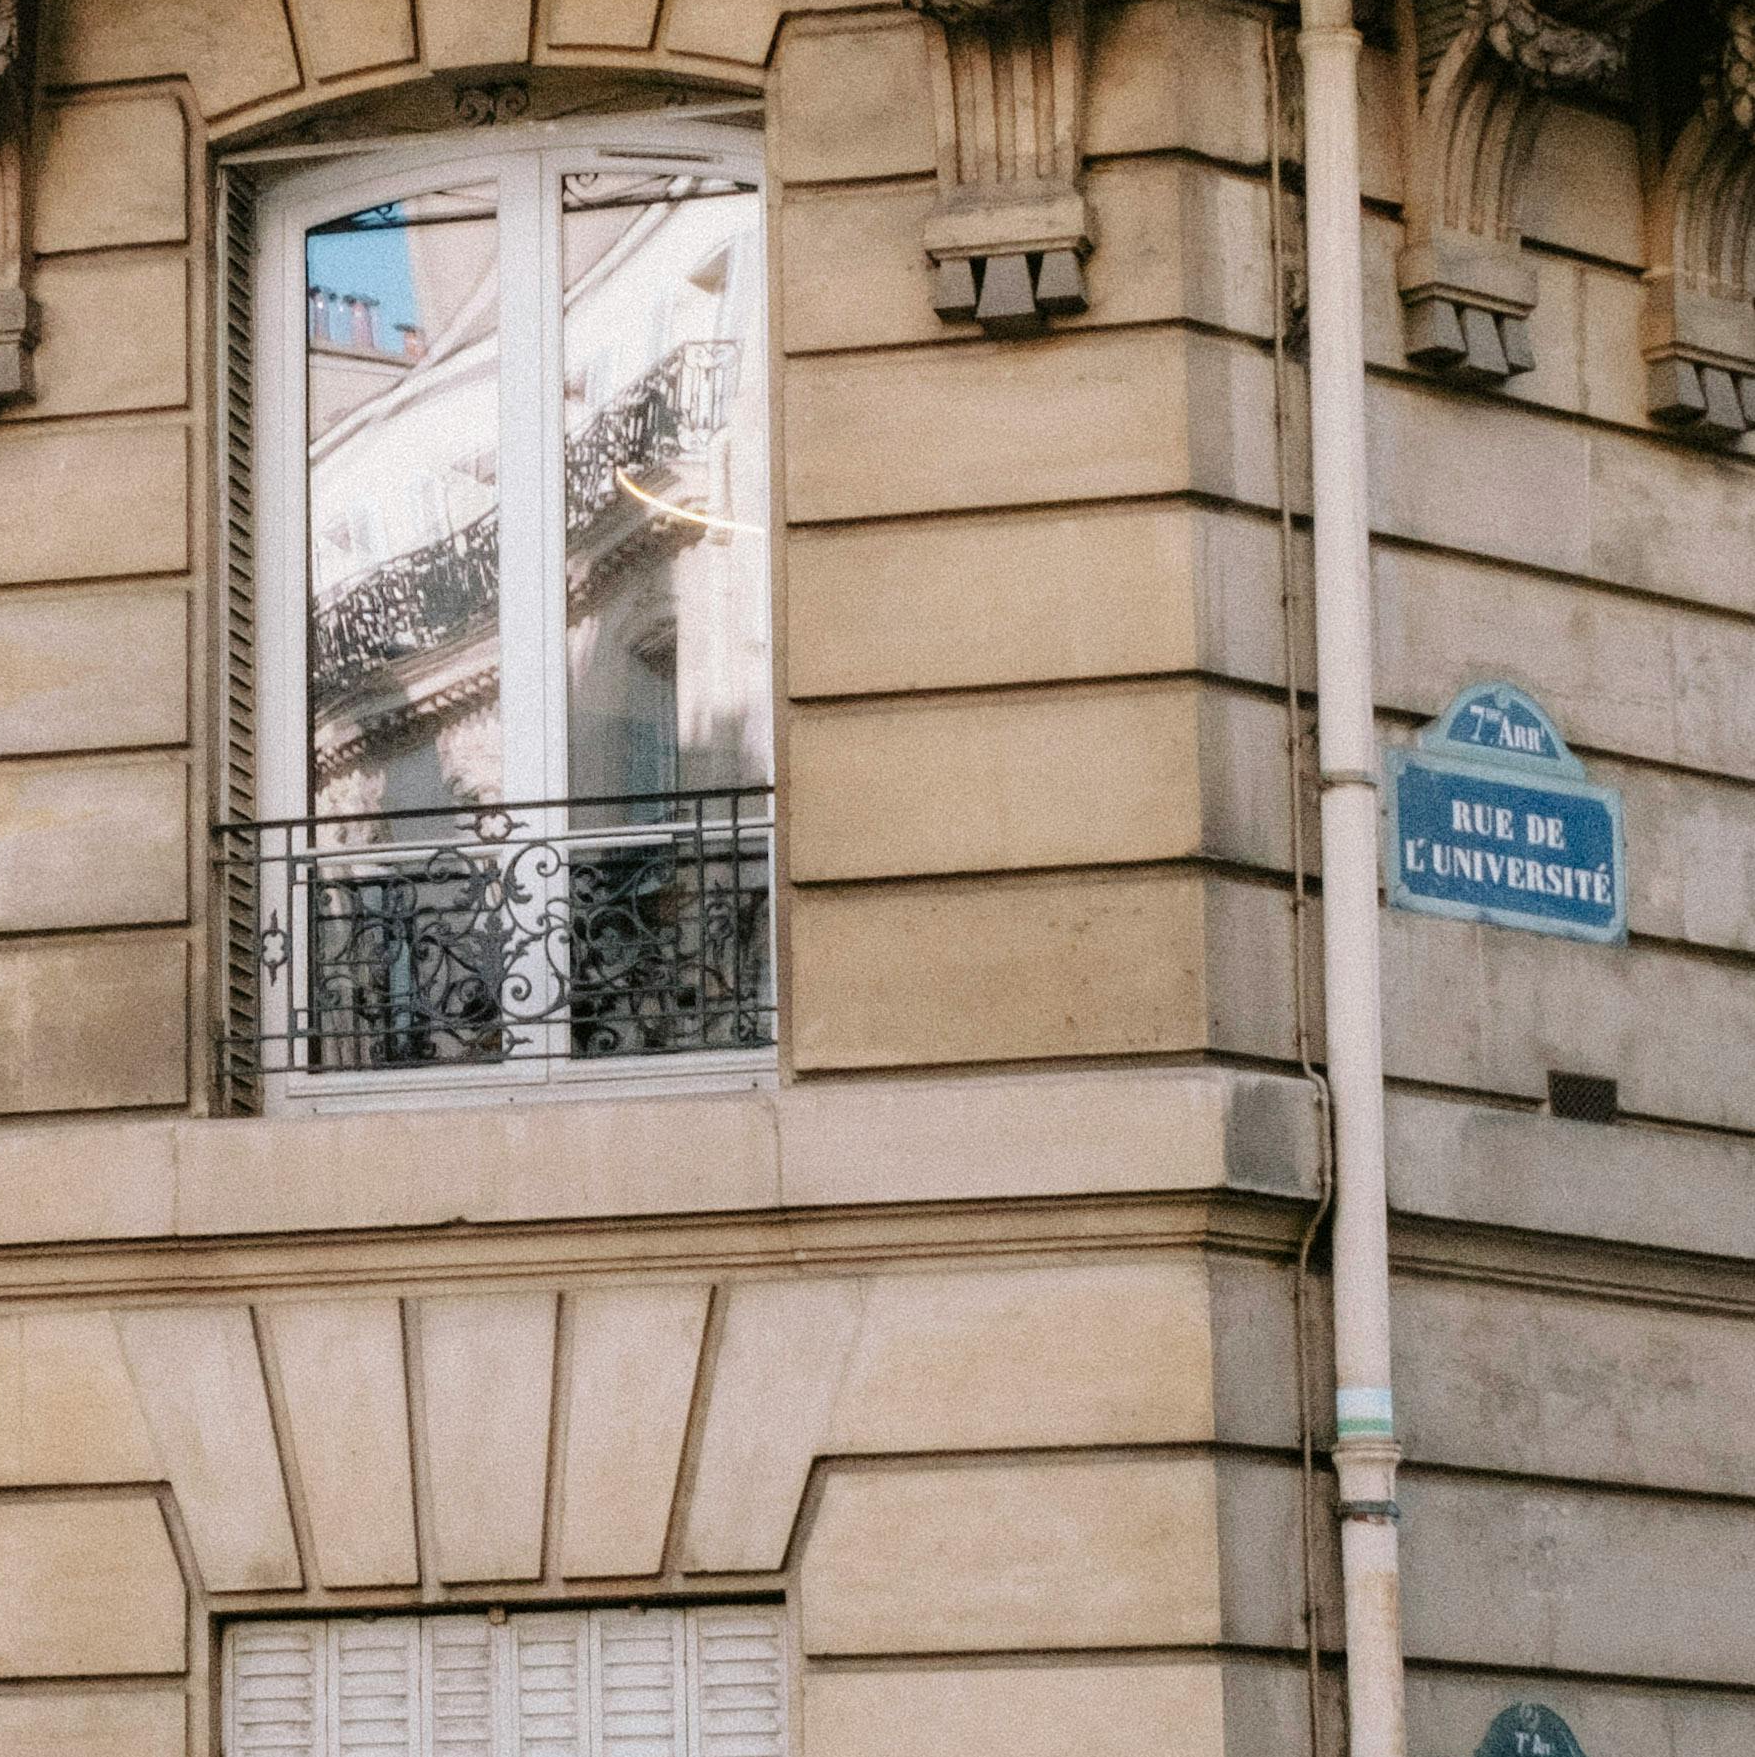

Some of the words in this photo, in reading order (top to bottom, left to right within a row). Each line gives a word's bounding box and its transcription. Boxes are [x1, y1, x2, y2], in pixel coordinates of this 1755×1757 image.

[1451, 799, 1514, 840] RUE
[1526, 812, 1566, 851] DE
[1404, 837, 1612, 905] L'UNIVERSITÉ
